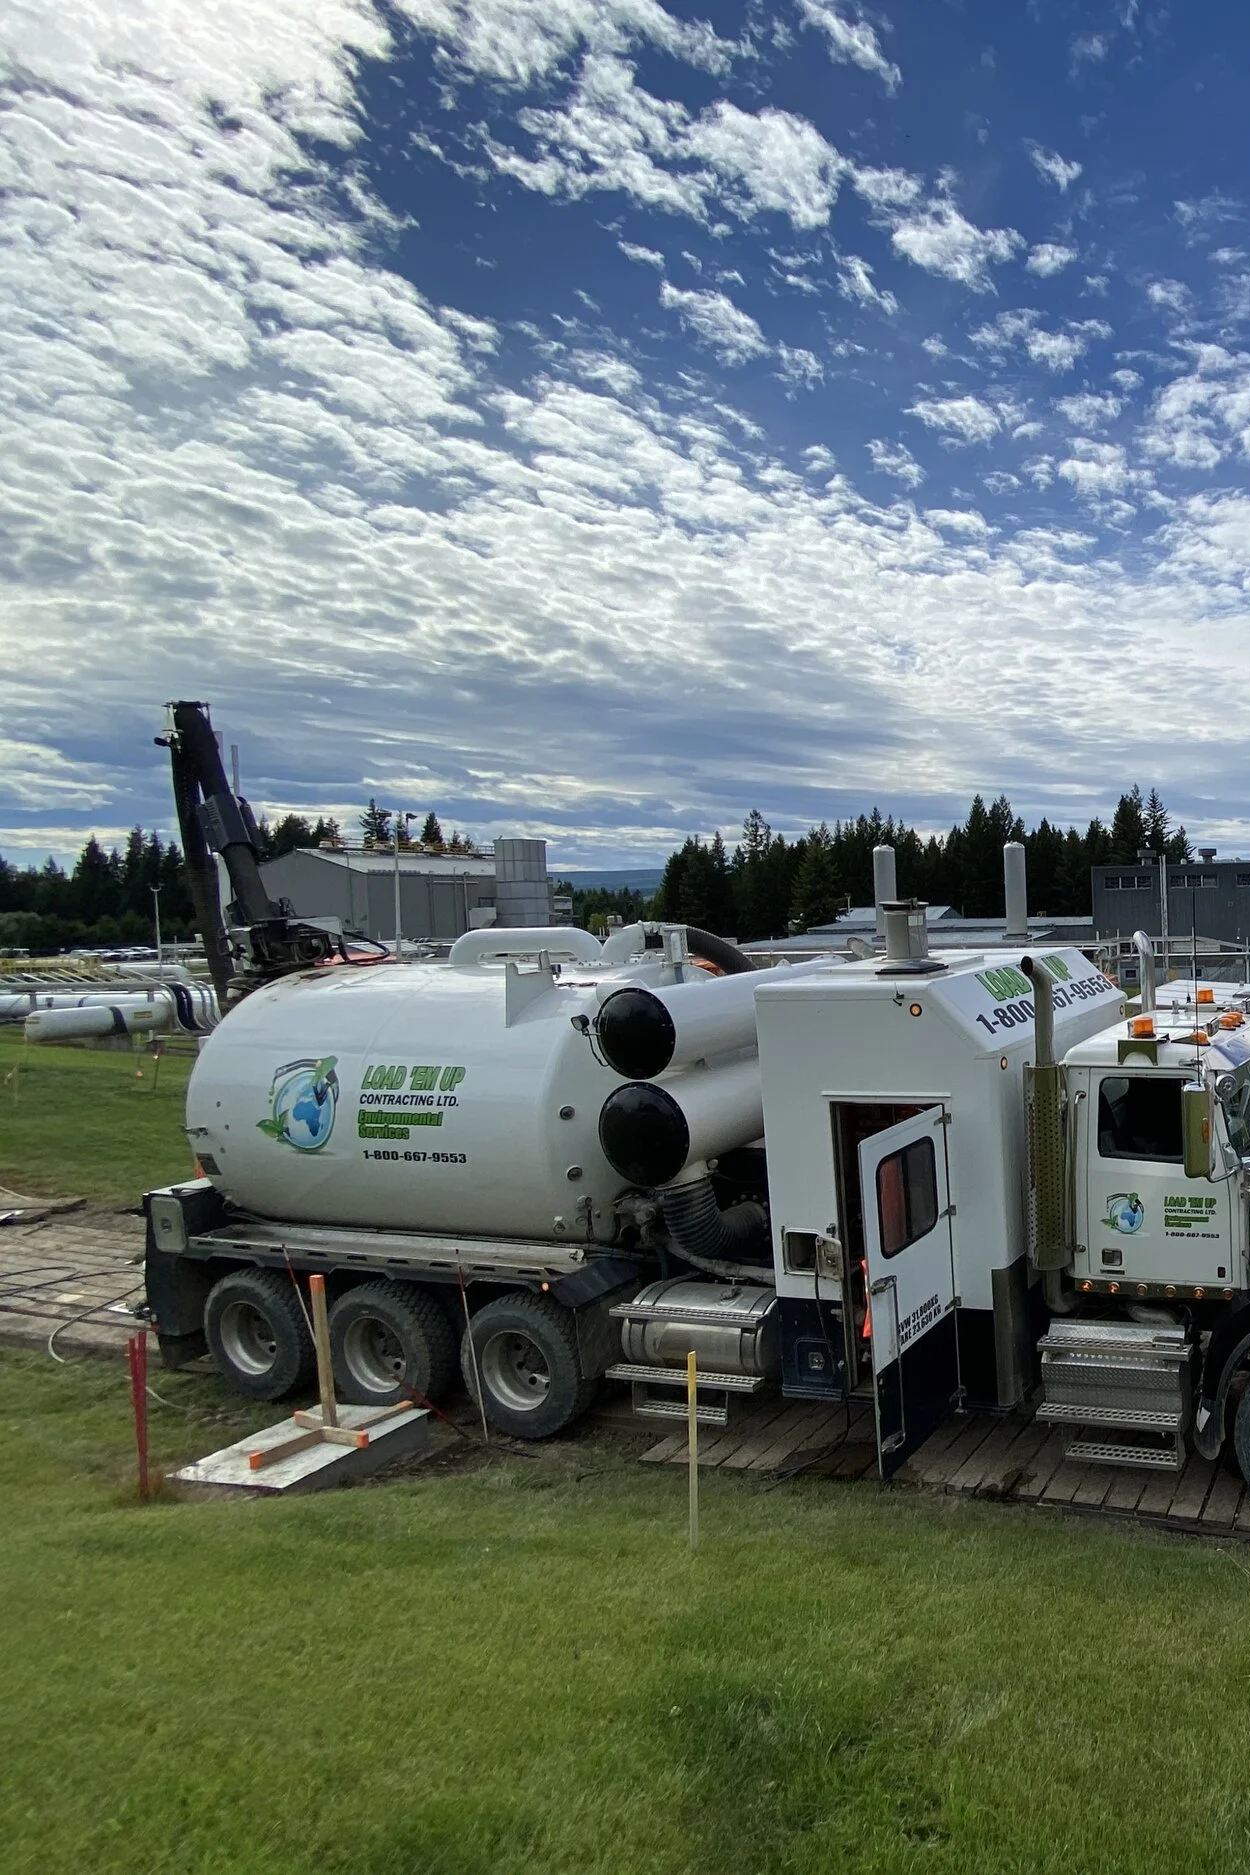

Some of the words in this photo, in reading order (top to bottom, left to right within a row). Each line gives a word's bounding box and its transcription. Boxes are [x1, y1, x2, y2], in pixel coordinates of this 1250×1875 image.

[974, 966, 1032, 1002] LOAD
[1041, 955, 1073, 981] UP
[976, 974, 1113, 1035] 1-80067-9553
[360, 1065, 407, 1090] LOAD
[410, 1065, 442, 1091] 'EM
[439, 1066, 466, 1091] UP
[360, 1094, 434, 1106] CONTRACTING
[436, 1095, 459, 1107] LTD.
[358, 1109, 443, 1126] Environmental
[358, 1123, 410, 1140] Services
[363, 1150, 467, 1163] 1-800-667-9553
[1164, 1196, 1187, 1207] LOAD
[1204, 1198, 1217, 1208] UP
